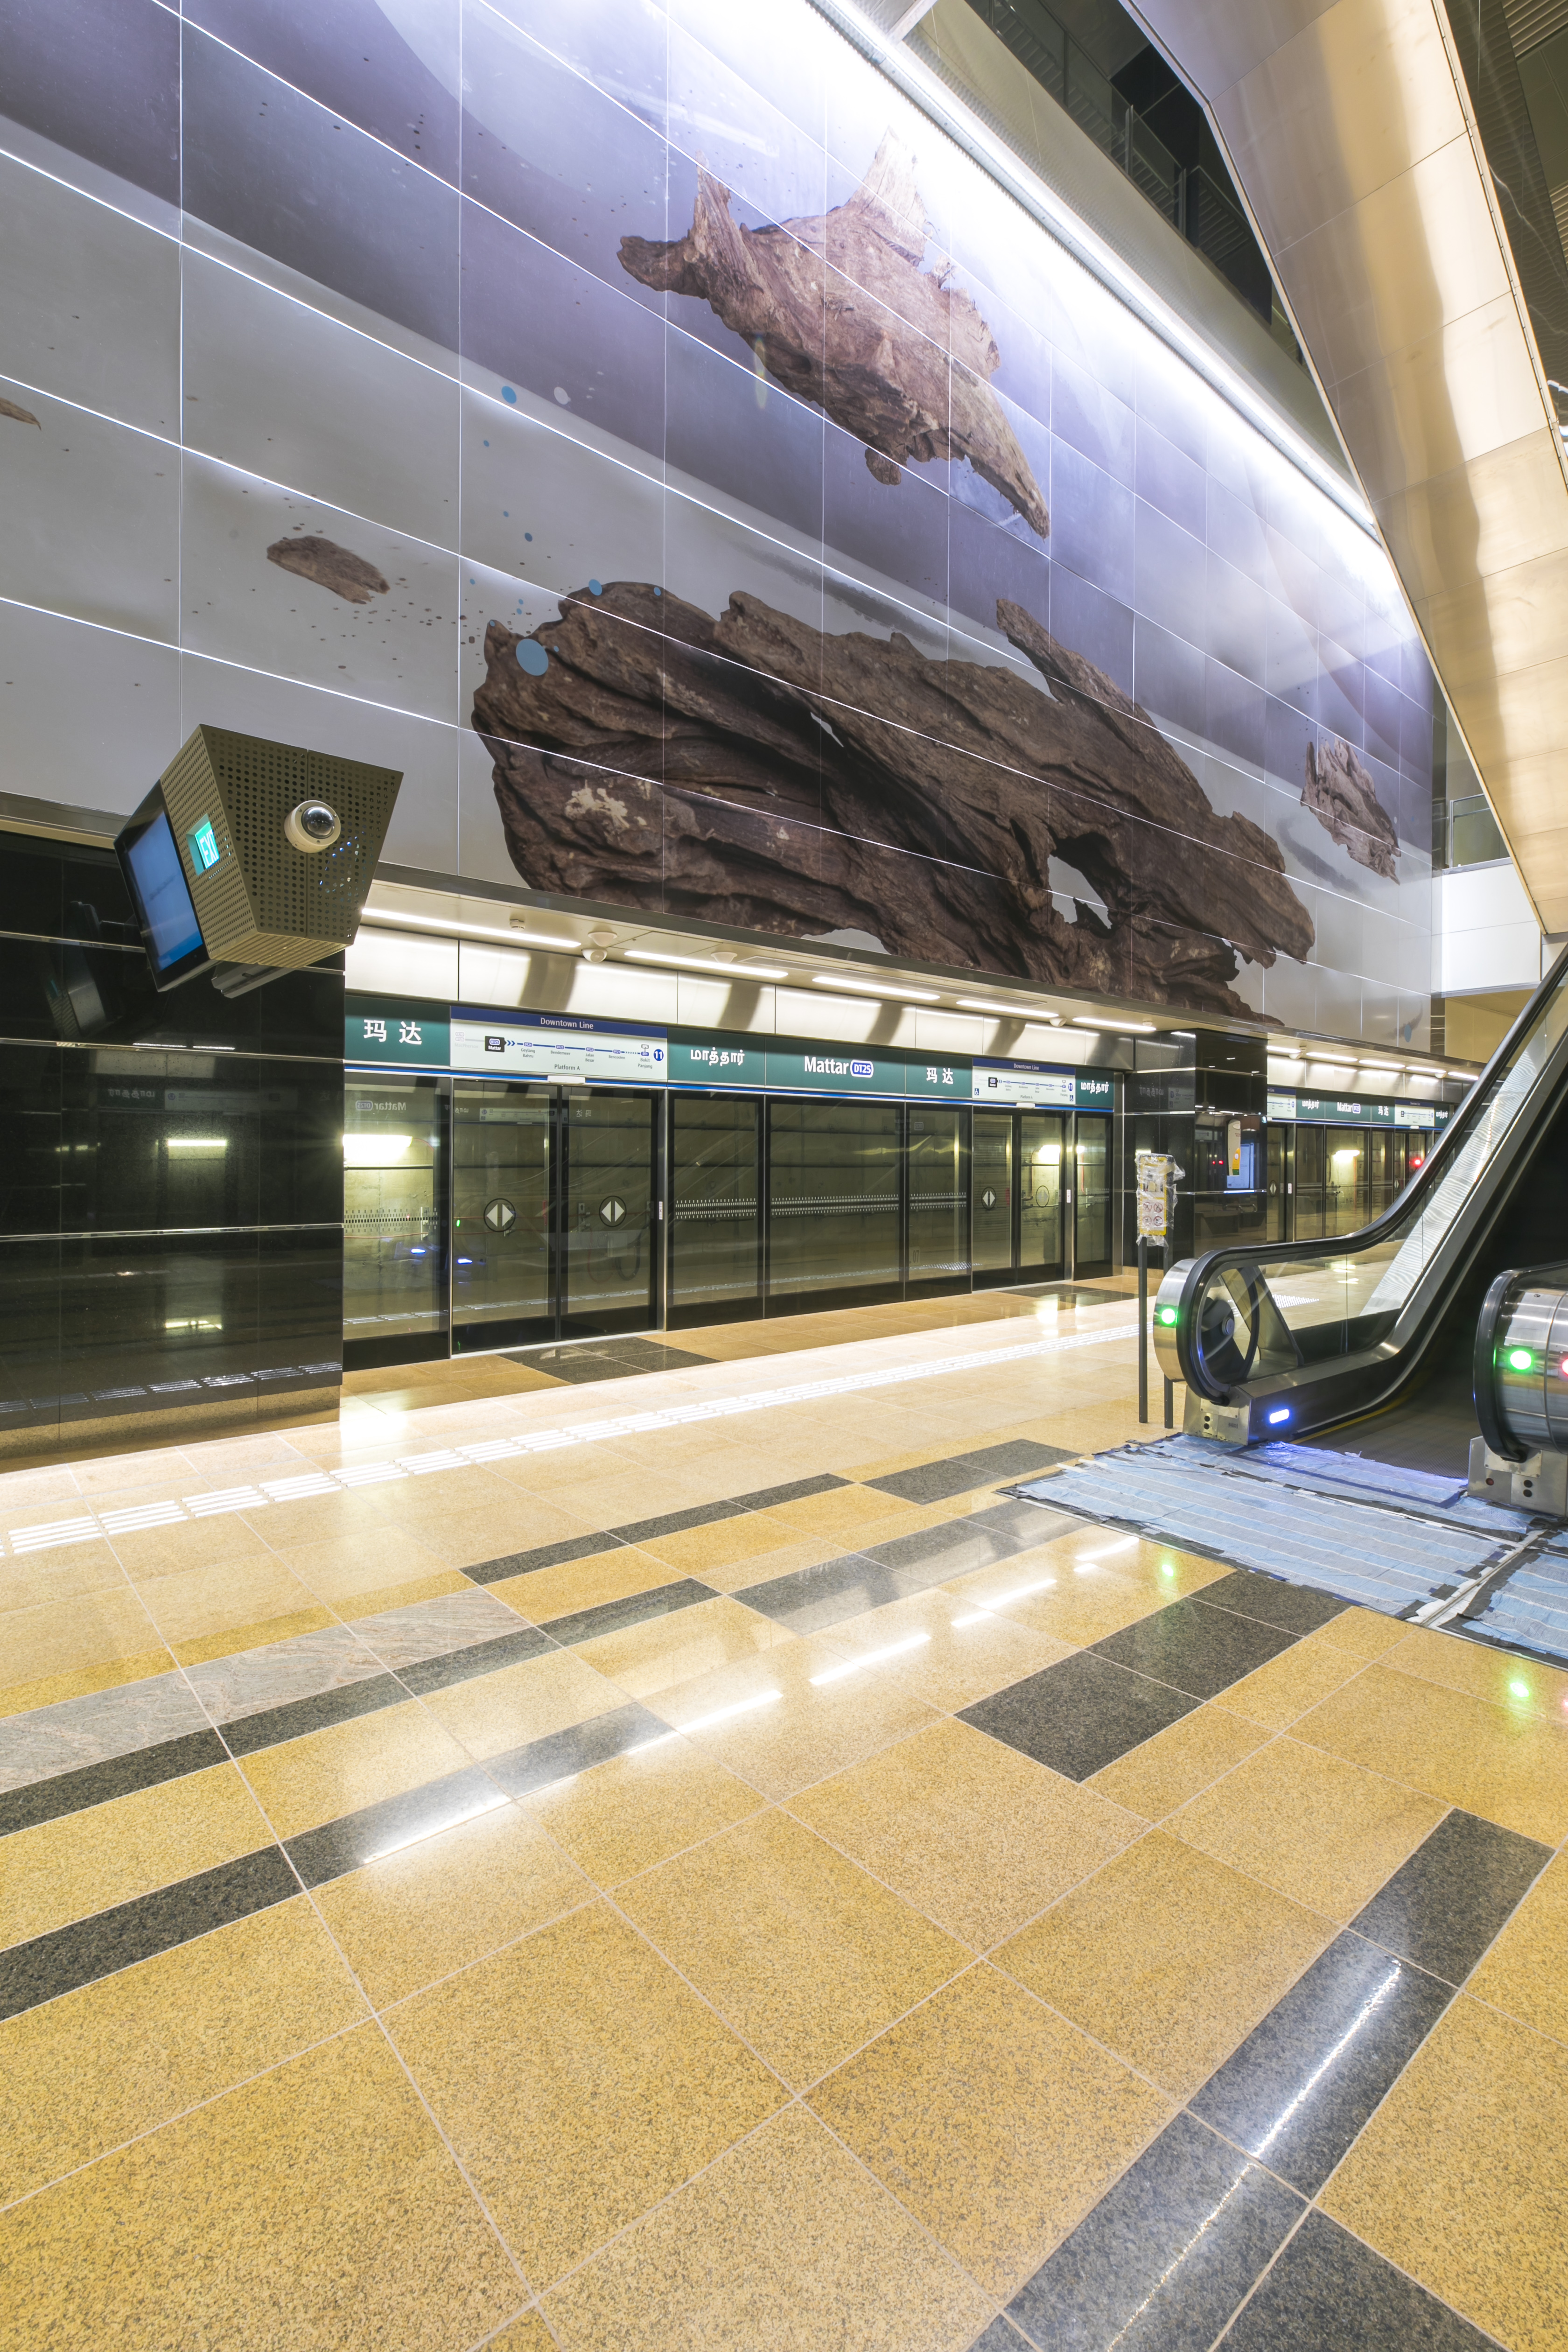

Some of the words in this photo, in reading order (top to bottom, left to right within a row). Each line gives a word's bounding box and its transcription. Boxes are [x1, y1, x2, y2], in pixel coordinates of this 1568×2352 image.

[199, 829, 219, 866] EXI
[364, 1019, 422, 1045] 玛达
[540, 1017, 577, 1028] Downtown
[579, 1021, 594, 1029] Line
[654, 1050, 662, 1059] 11
[690, 1047, 745, 1066] மாத்தார்
[805, 1056, 849, 1074] Mattar
[854, 1064, 871, 1074] DT25
[926, 1067, 953, 1085] 玛达
[1081, 1080, 1109, 1094] மாத்தார்
[1337, 1102, 1352, 1112] Mattar
